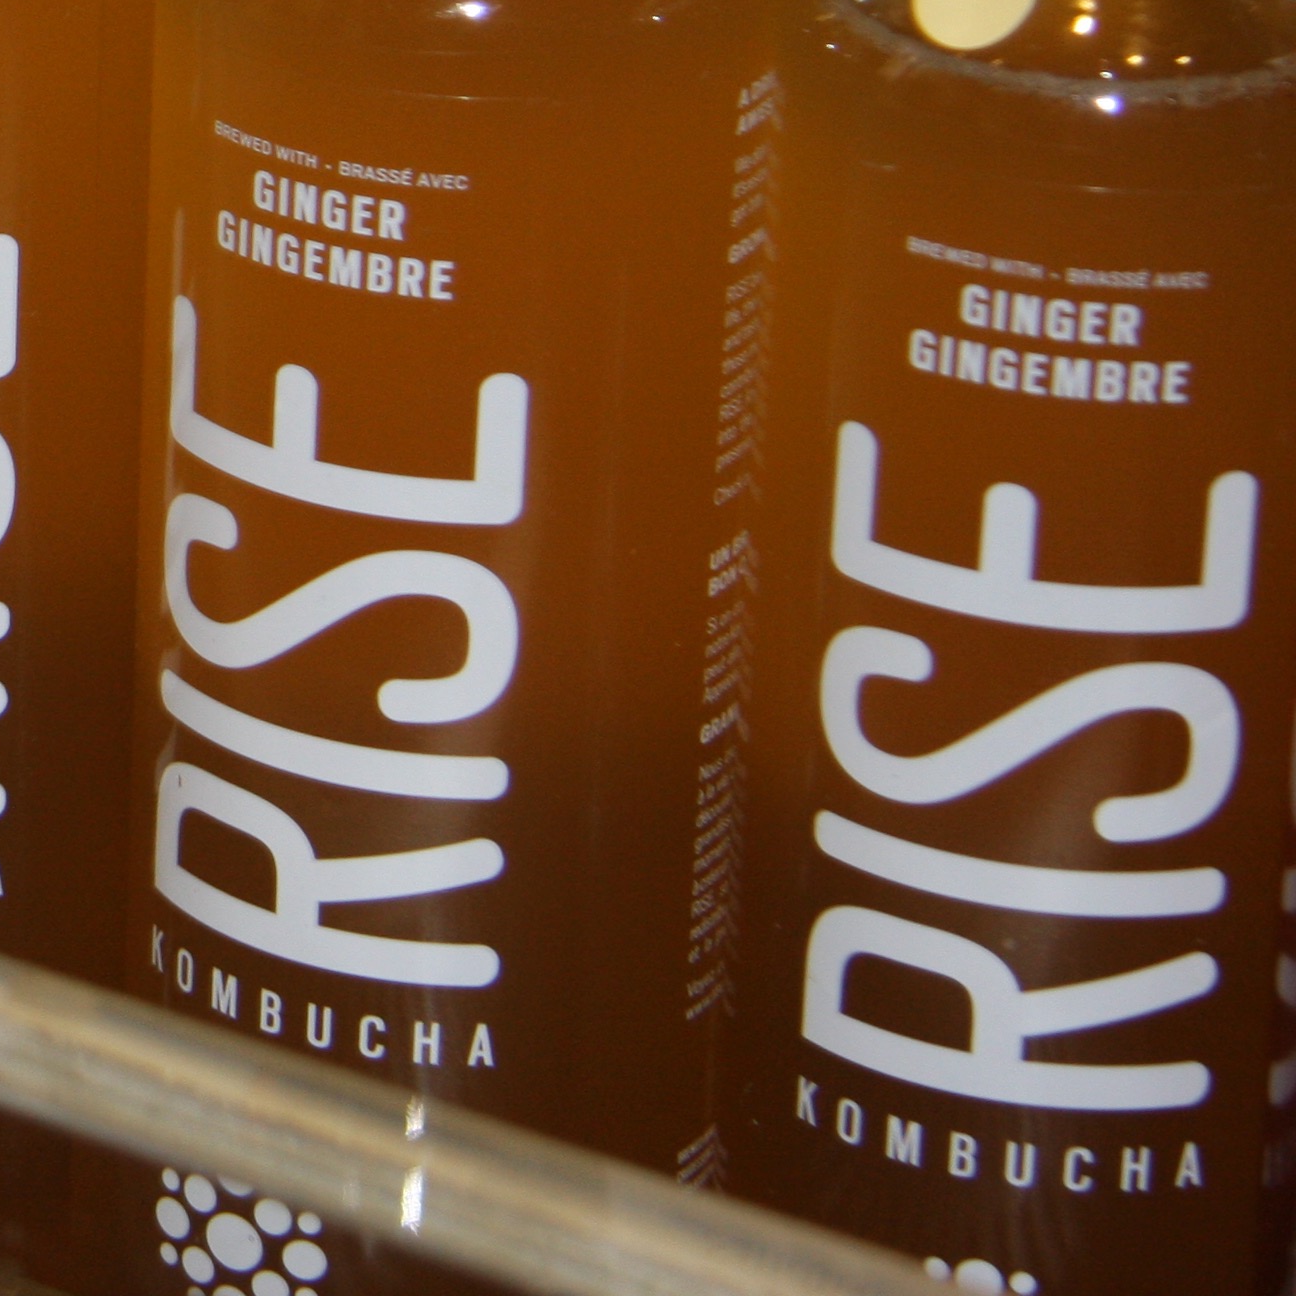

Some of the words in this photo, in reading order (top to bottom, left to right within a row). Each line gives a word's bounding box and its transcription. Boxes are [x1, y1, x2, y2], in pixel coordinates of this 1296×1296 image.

[214, 120, 272, 155] BREWED
[275, 145, 318, 169] WITH
[338, 160, 413, 186] BRASSÉ
[415, 173, 469, 191] AVEC
[252, 169, 406, 241] GINGER
[216, 209, 455, 301] GINGEMBRE
[959, 284, 1143, 347] GINGER
[909, 328, 1191, 404] GINGEMBRE
[154, 293, 529, 988] RISE
[801, 419, 1259, 1112] RISE
[151, 923, 495, 1068] KOMBUCHA
[796, 1075, 1205, 1192] KOMBUCHA
